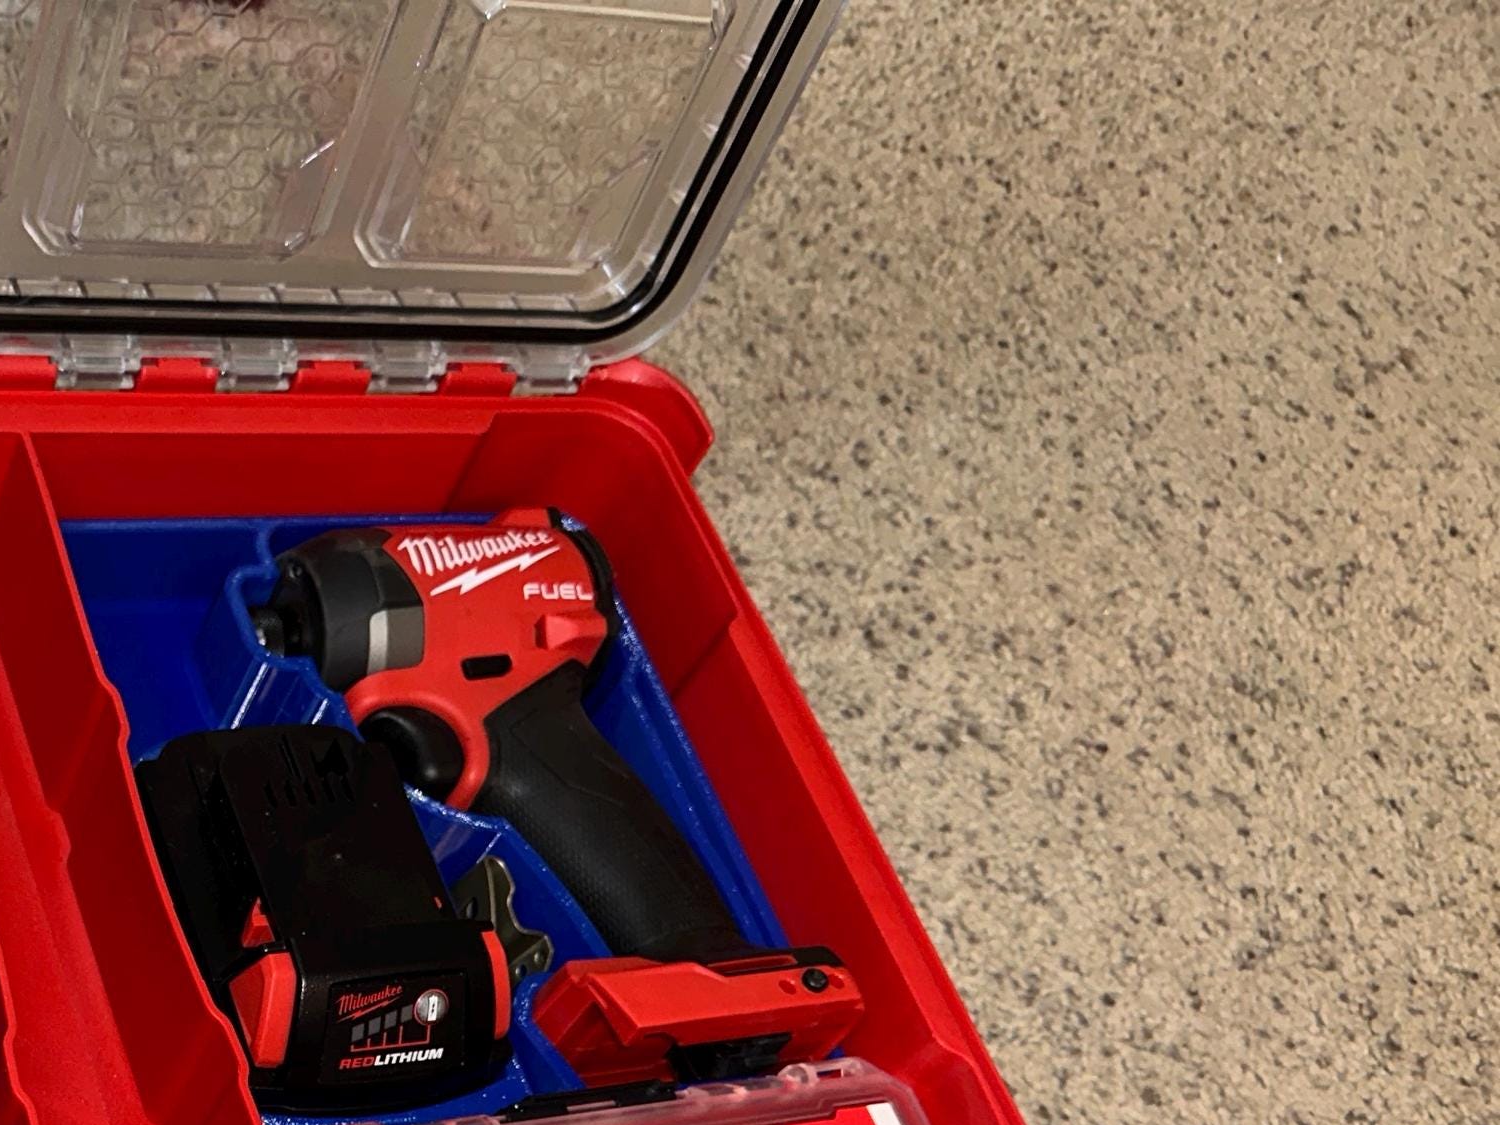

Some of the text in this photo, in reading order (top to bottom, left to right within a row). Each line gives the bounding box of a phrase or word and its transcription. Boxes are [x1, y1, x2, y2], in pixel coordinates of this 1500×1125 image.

[398, 531, 553, 576] Milwaukee
[523, 582, 593, 600] FUEL
[336, 985, 403, 1015] Milwaukee
[339, 1048, 444, 1070] REDLITHIUM
